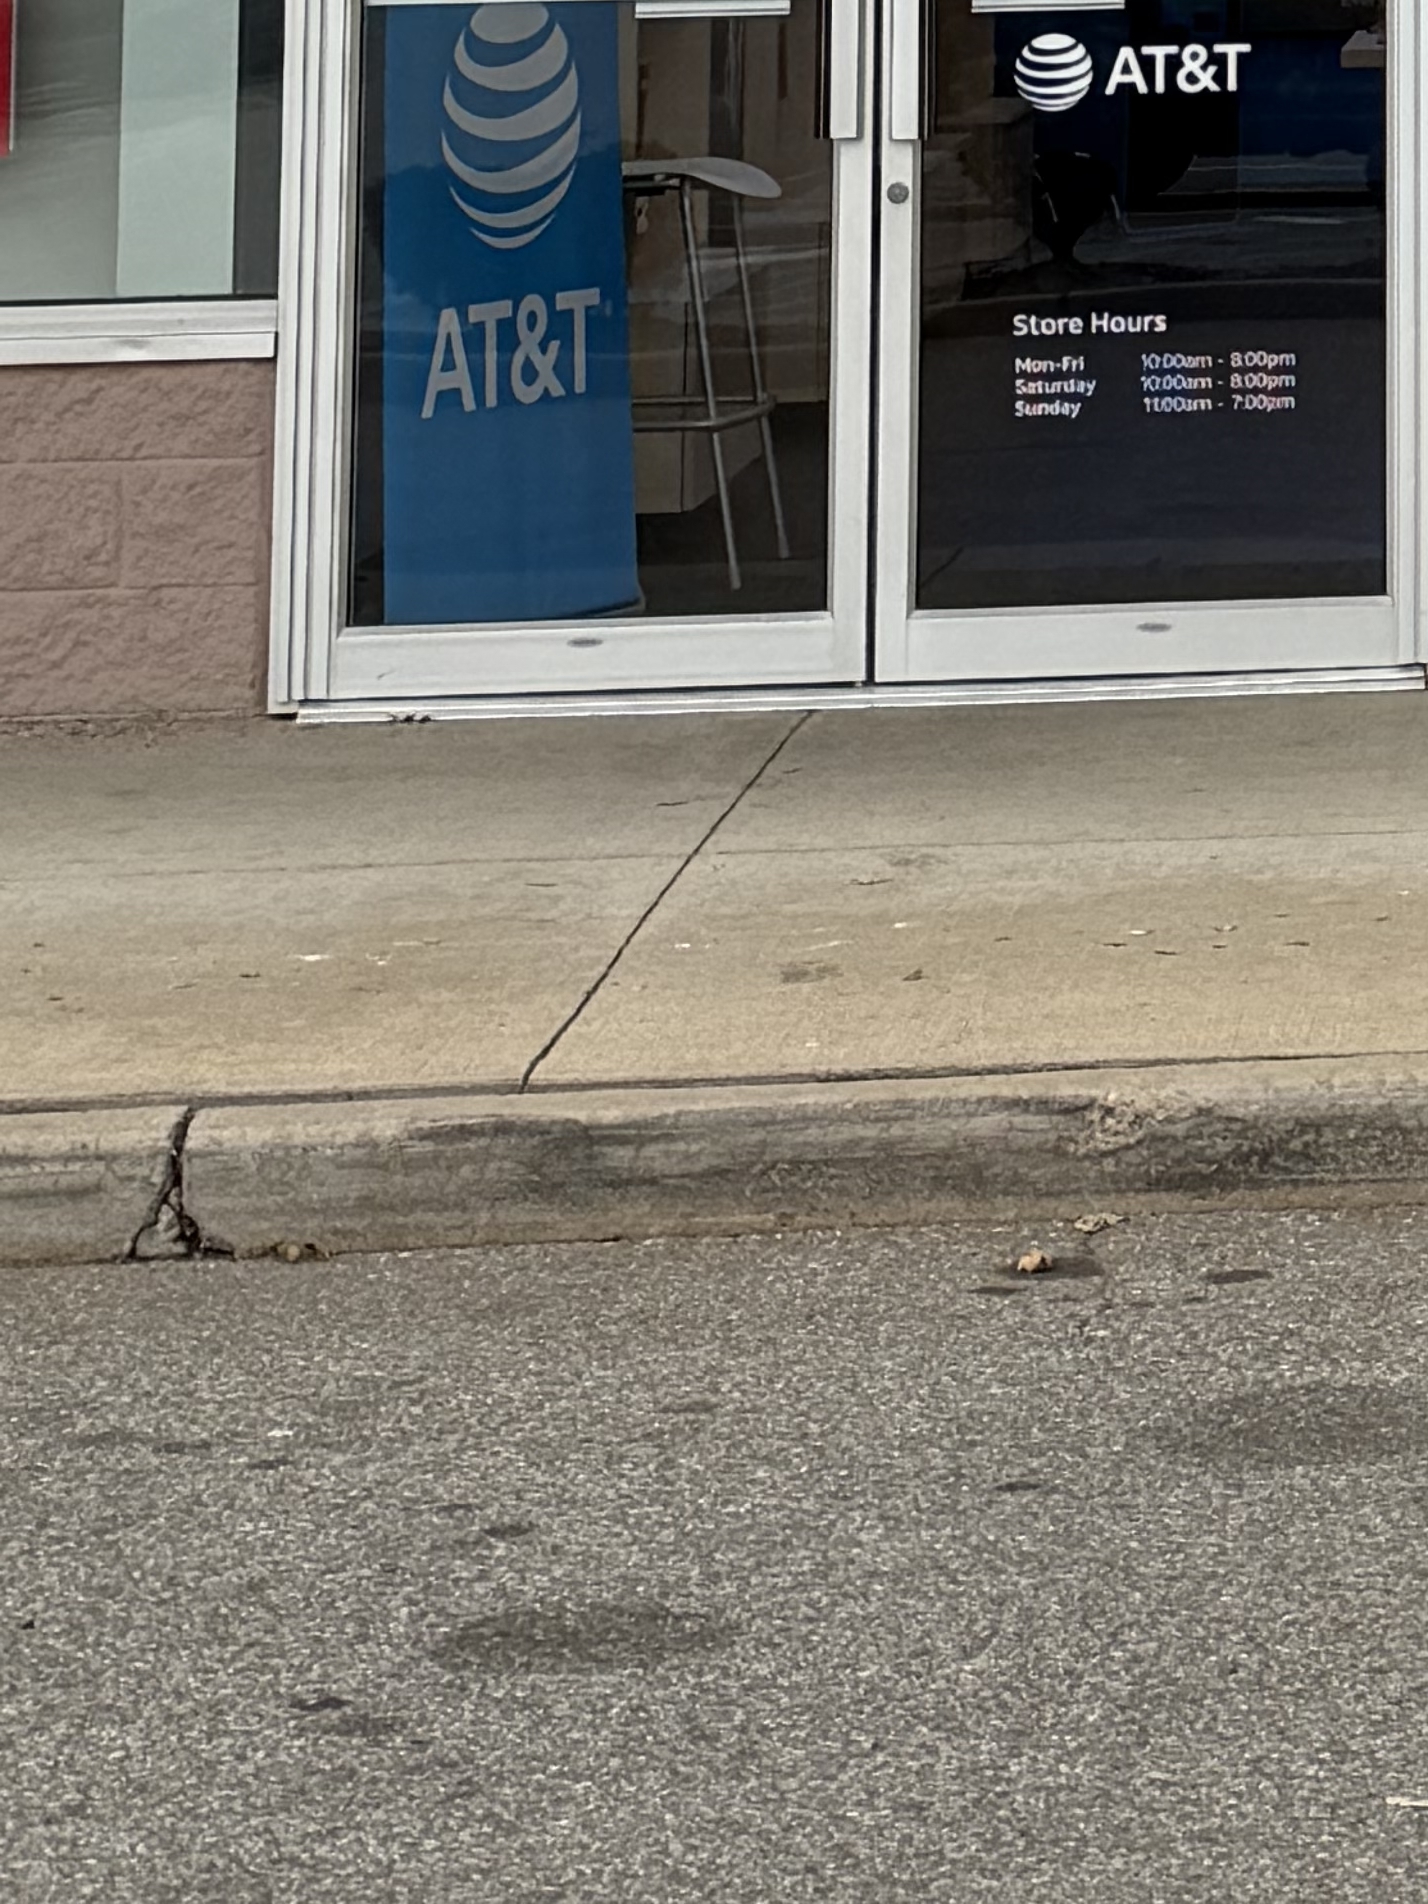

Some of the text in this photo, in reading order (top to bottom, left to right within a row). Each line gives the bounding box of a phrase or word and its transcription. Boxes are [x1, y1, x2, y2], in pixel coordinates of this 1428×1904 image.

[1105, 43, 1251, 96] AT&T
[1012, 312, 1168, 337] Store Hours
[421, 287, 600, 419] AT&T
[1014, 355, 1085, 374] Mon-Fri
[1014, 378, 1097, 397] Saturday
[1014, 399, 1082, 419] Sunday
